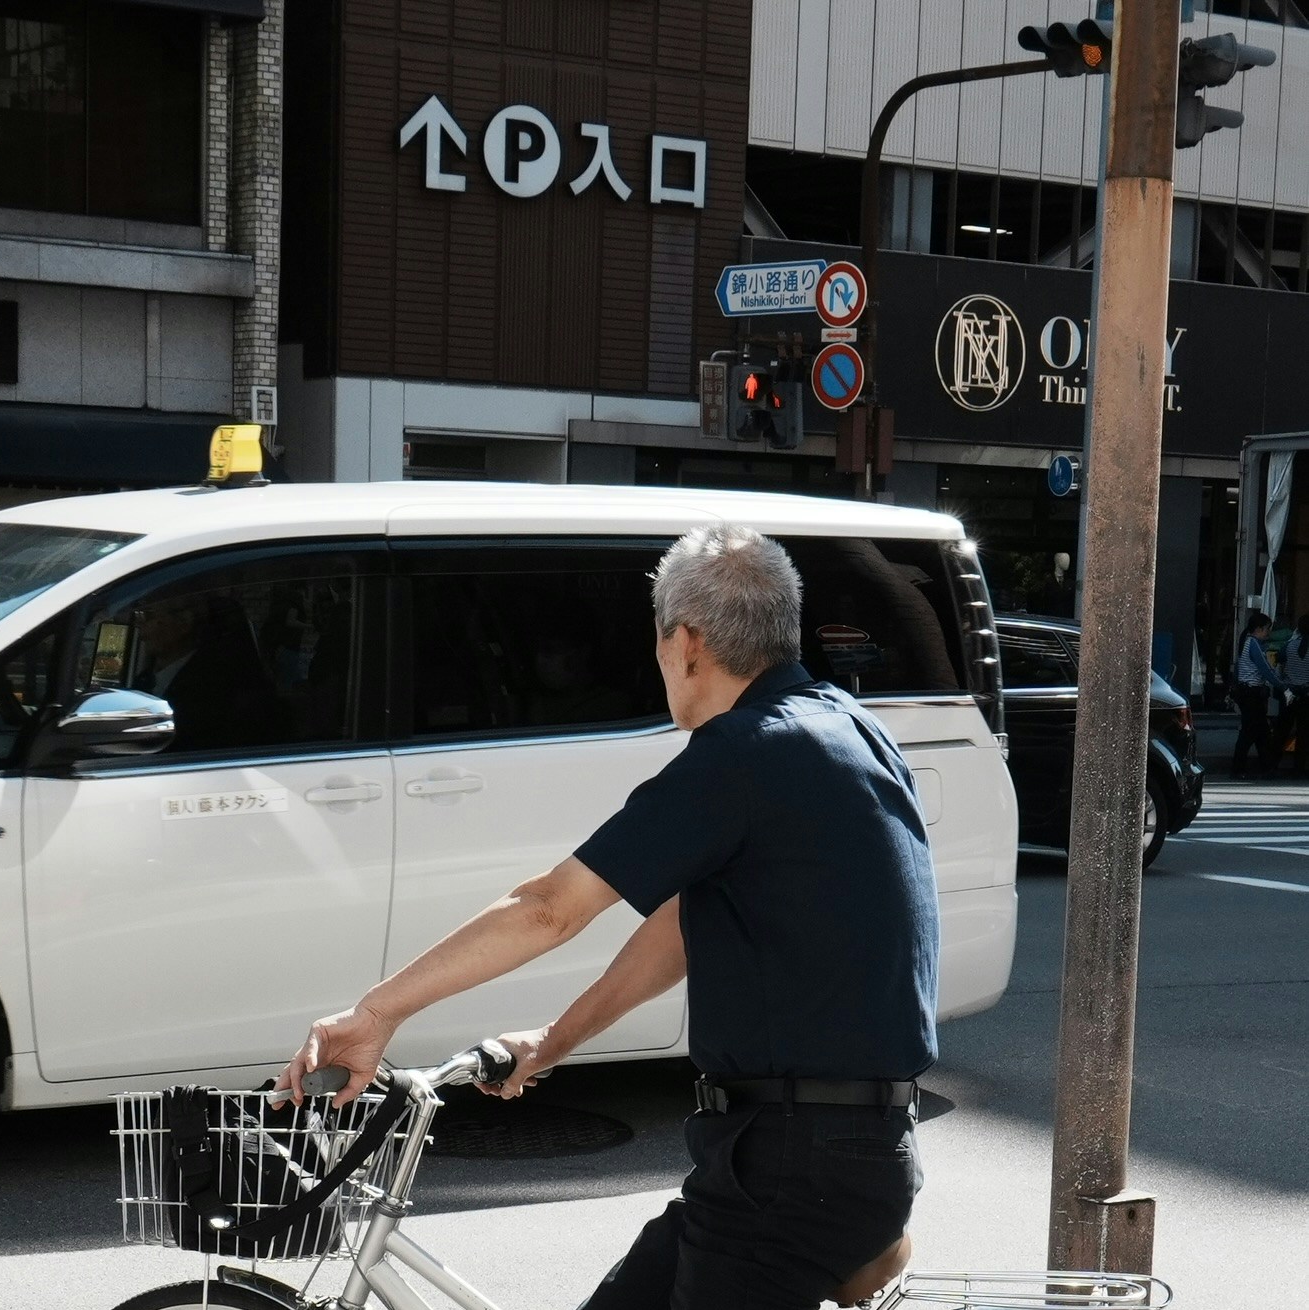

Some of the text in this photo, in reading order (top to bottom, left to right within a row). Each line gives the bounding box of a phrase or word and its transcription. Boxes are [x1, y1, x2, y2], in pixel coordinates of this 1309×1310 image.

[569, 122, 708, 209] 入口
[731, 269, 816, 295] 錦小路通り
[741, 293, 807, 309] Nishikikoji-dori
